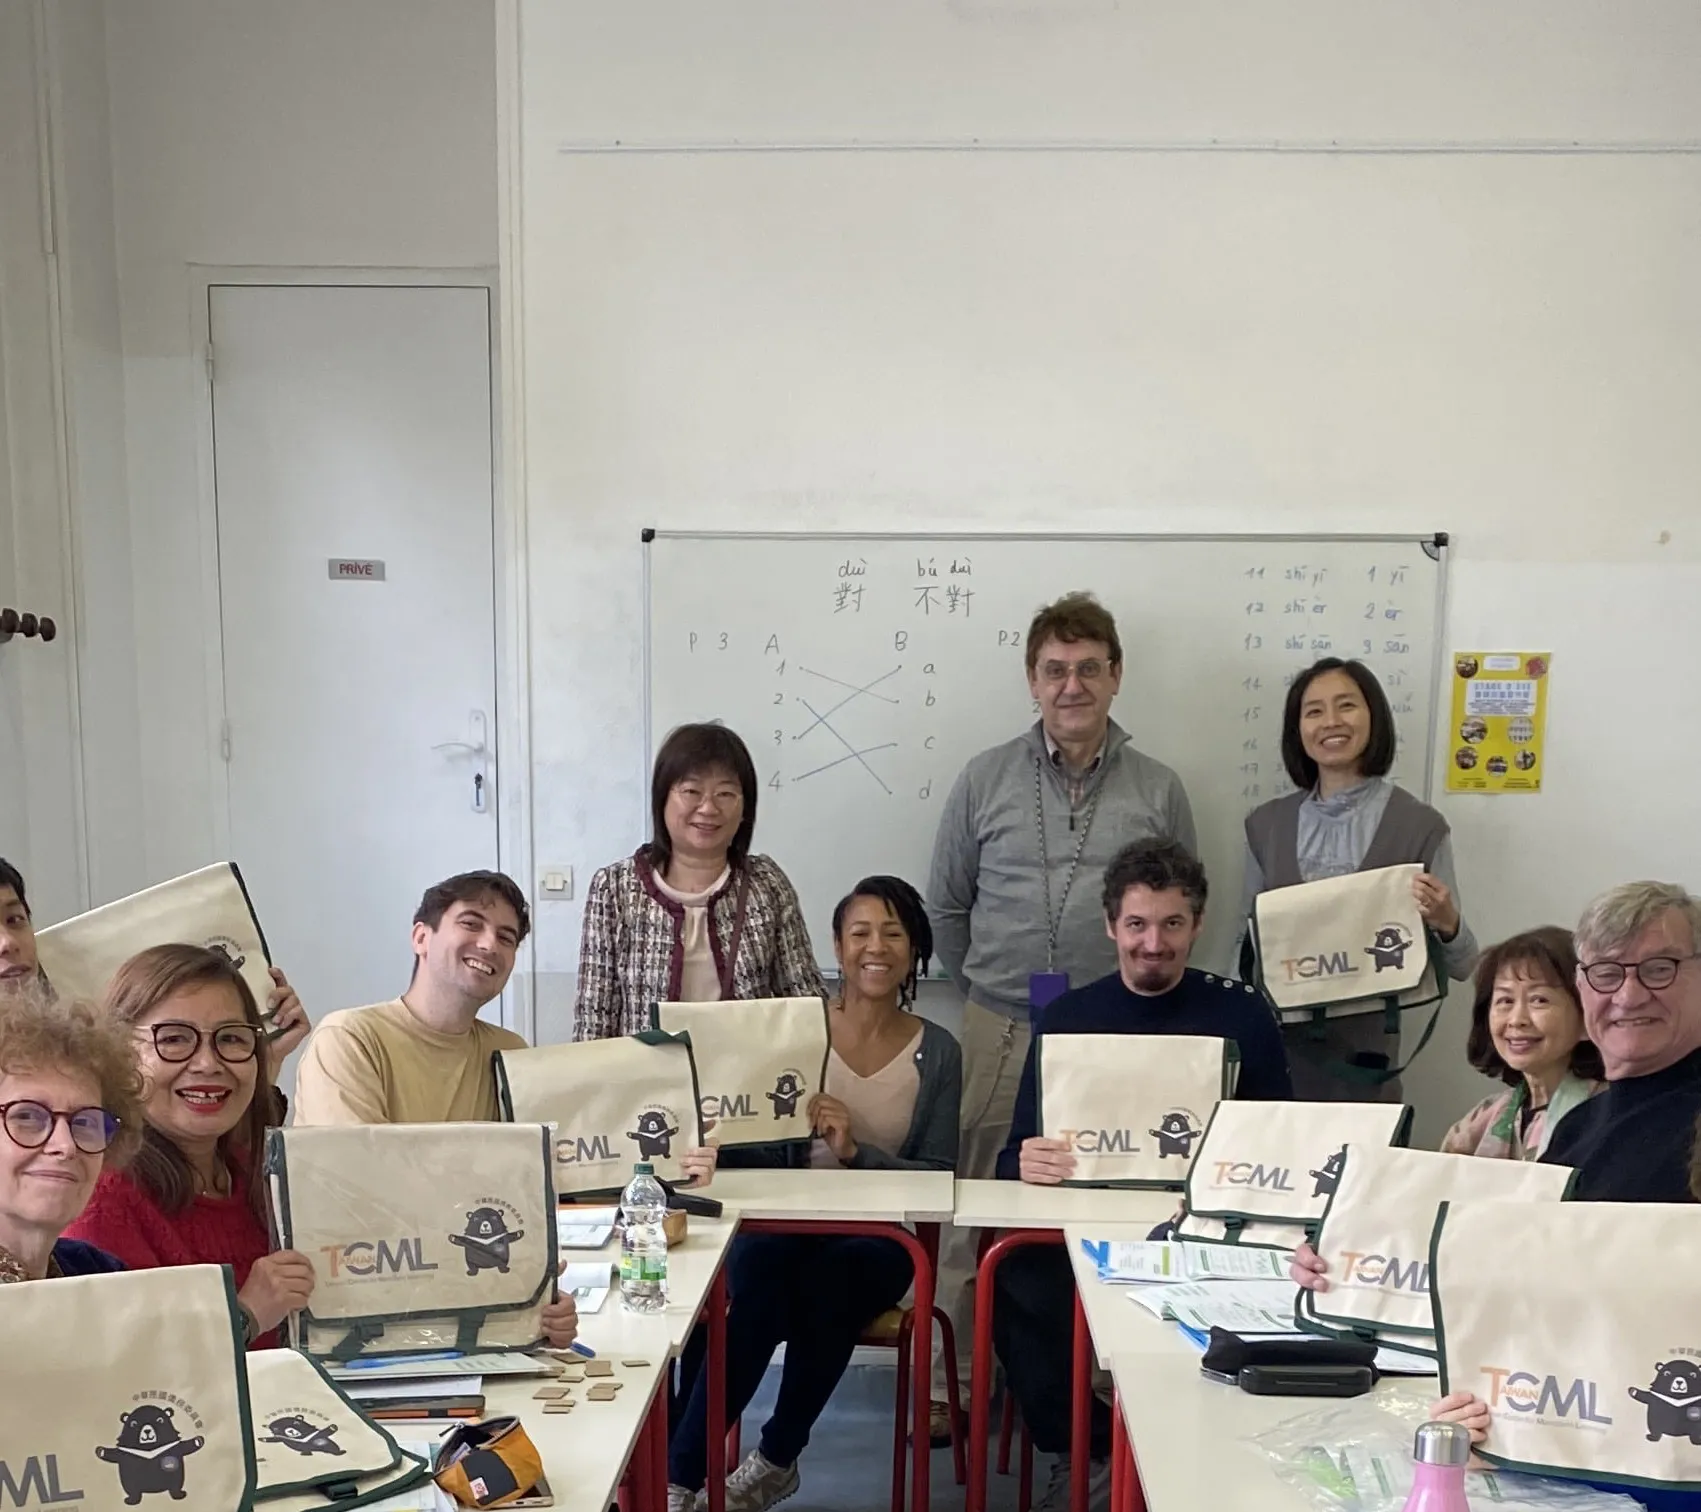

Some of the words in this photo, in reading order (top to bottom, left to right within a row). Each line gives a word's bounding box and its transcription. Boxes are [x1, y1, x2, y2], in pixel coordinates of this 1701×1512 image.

[833, 581, 867, 614] 對
[1363, 602, 1375, 620] 2
[718, 632, 729, 651] 3
[763, 632, 780, 656] A
[895, 631, 908, 652] B
[773, 694, 784, 706] 2
[773, 730, 784, 744] 3
[768, 768, 785, 791] 4
[556, 1136, 621, 1164] CML
